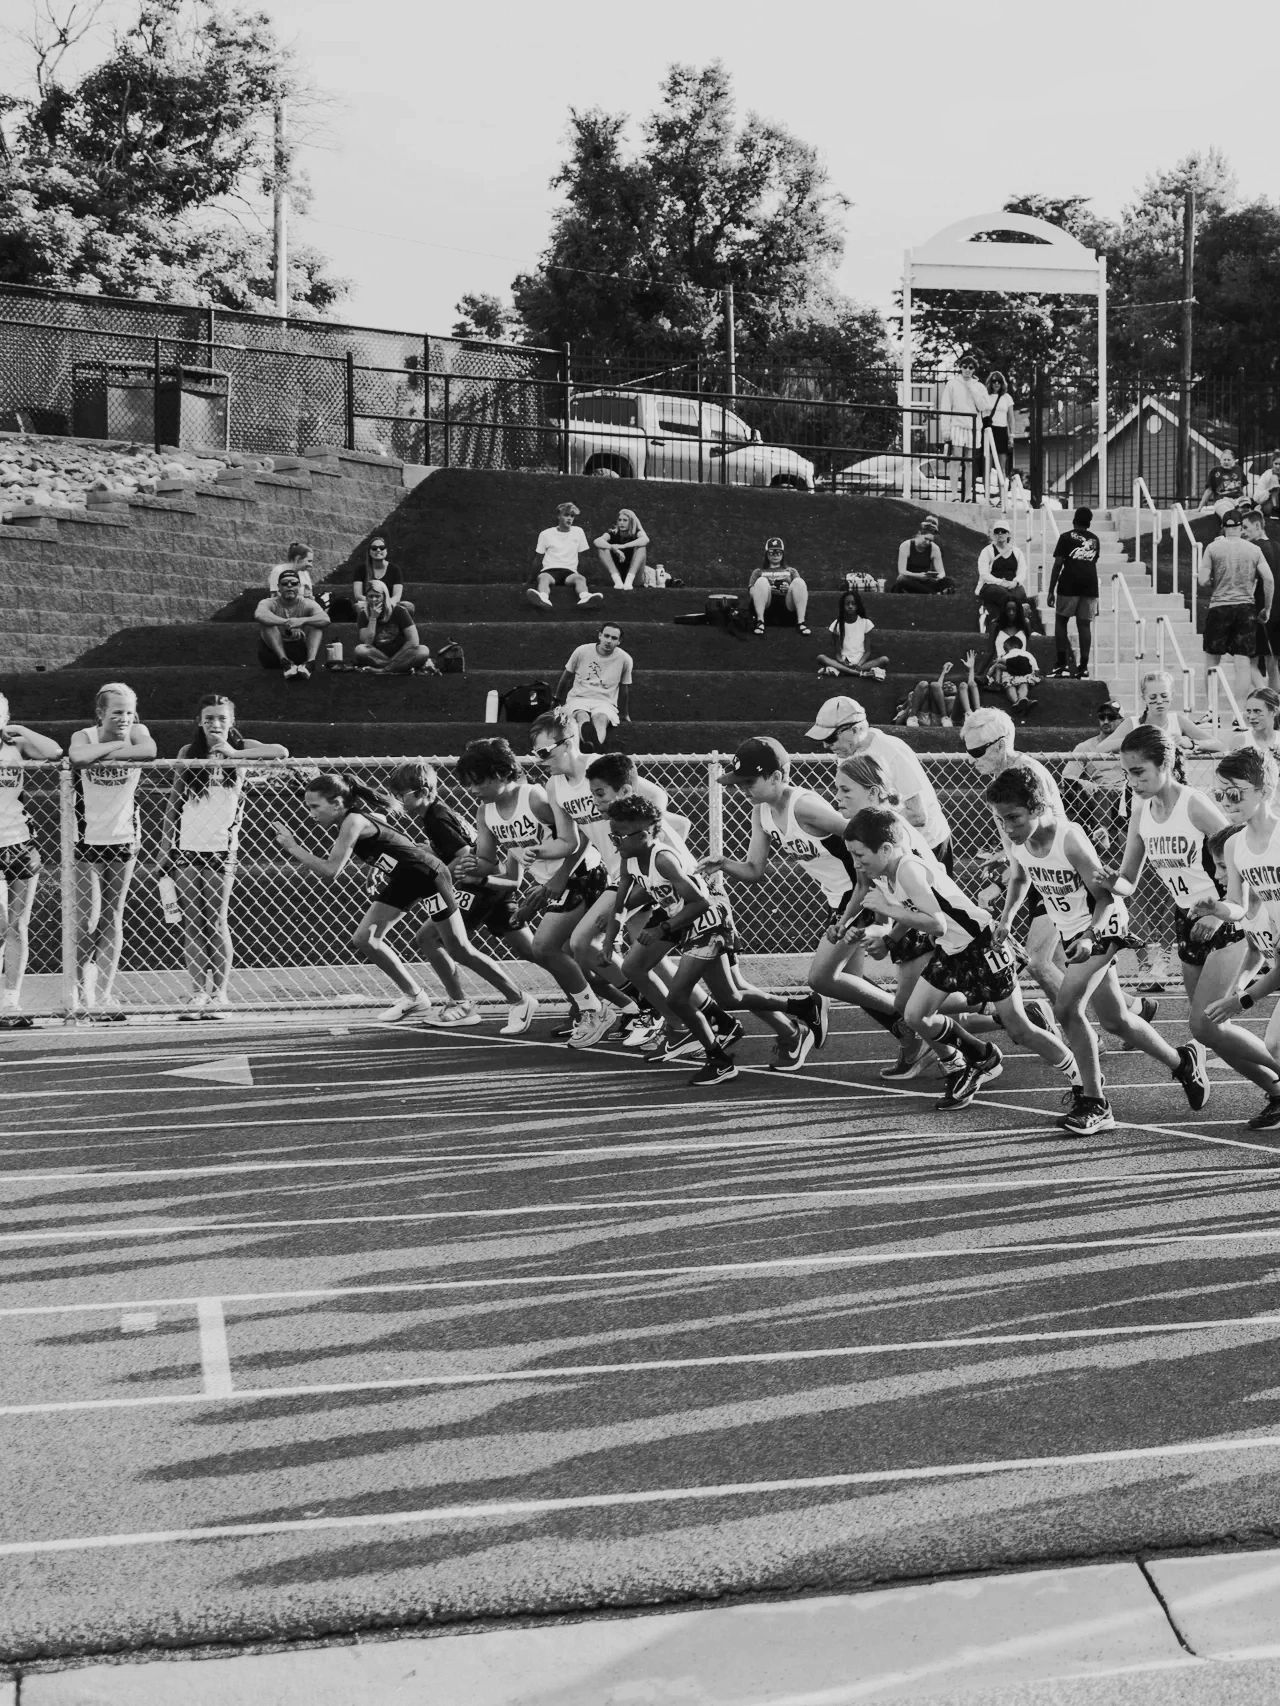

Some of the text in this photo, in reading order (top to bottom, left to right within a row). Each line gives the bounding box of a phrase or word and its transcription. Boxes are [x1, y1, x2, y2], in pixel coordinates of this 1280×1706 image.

[514, 815, 536, 837] 24
[1168, 875, 1190, 896] 14
[424, 896, 441, 915] 27
[1047, 896, 1071, 913] 15
[698, 908, 717, 930] 20
[988, 949, 1010, 971] 16
